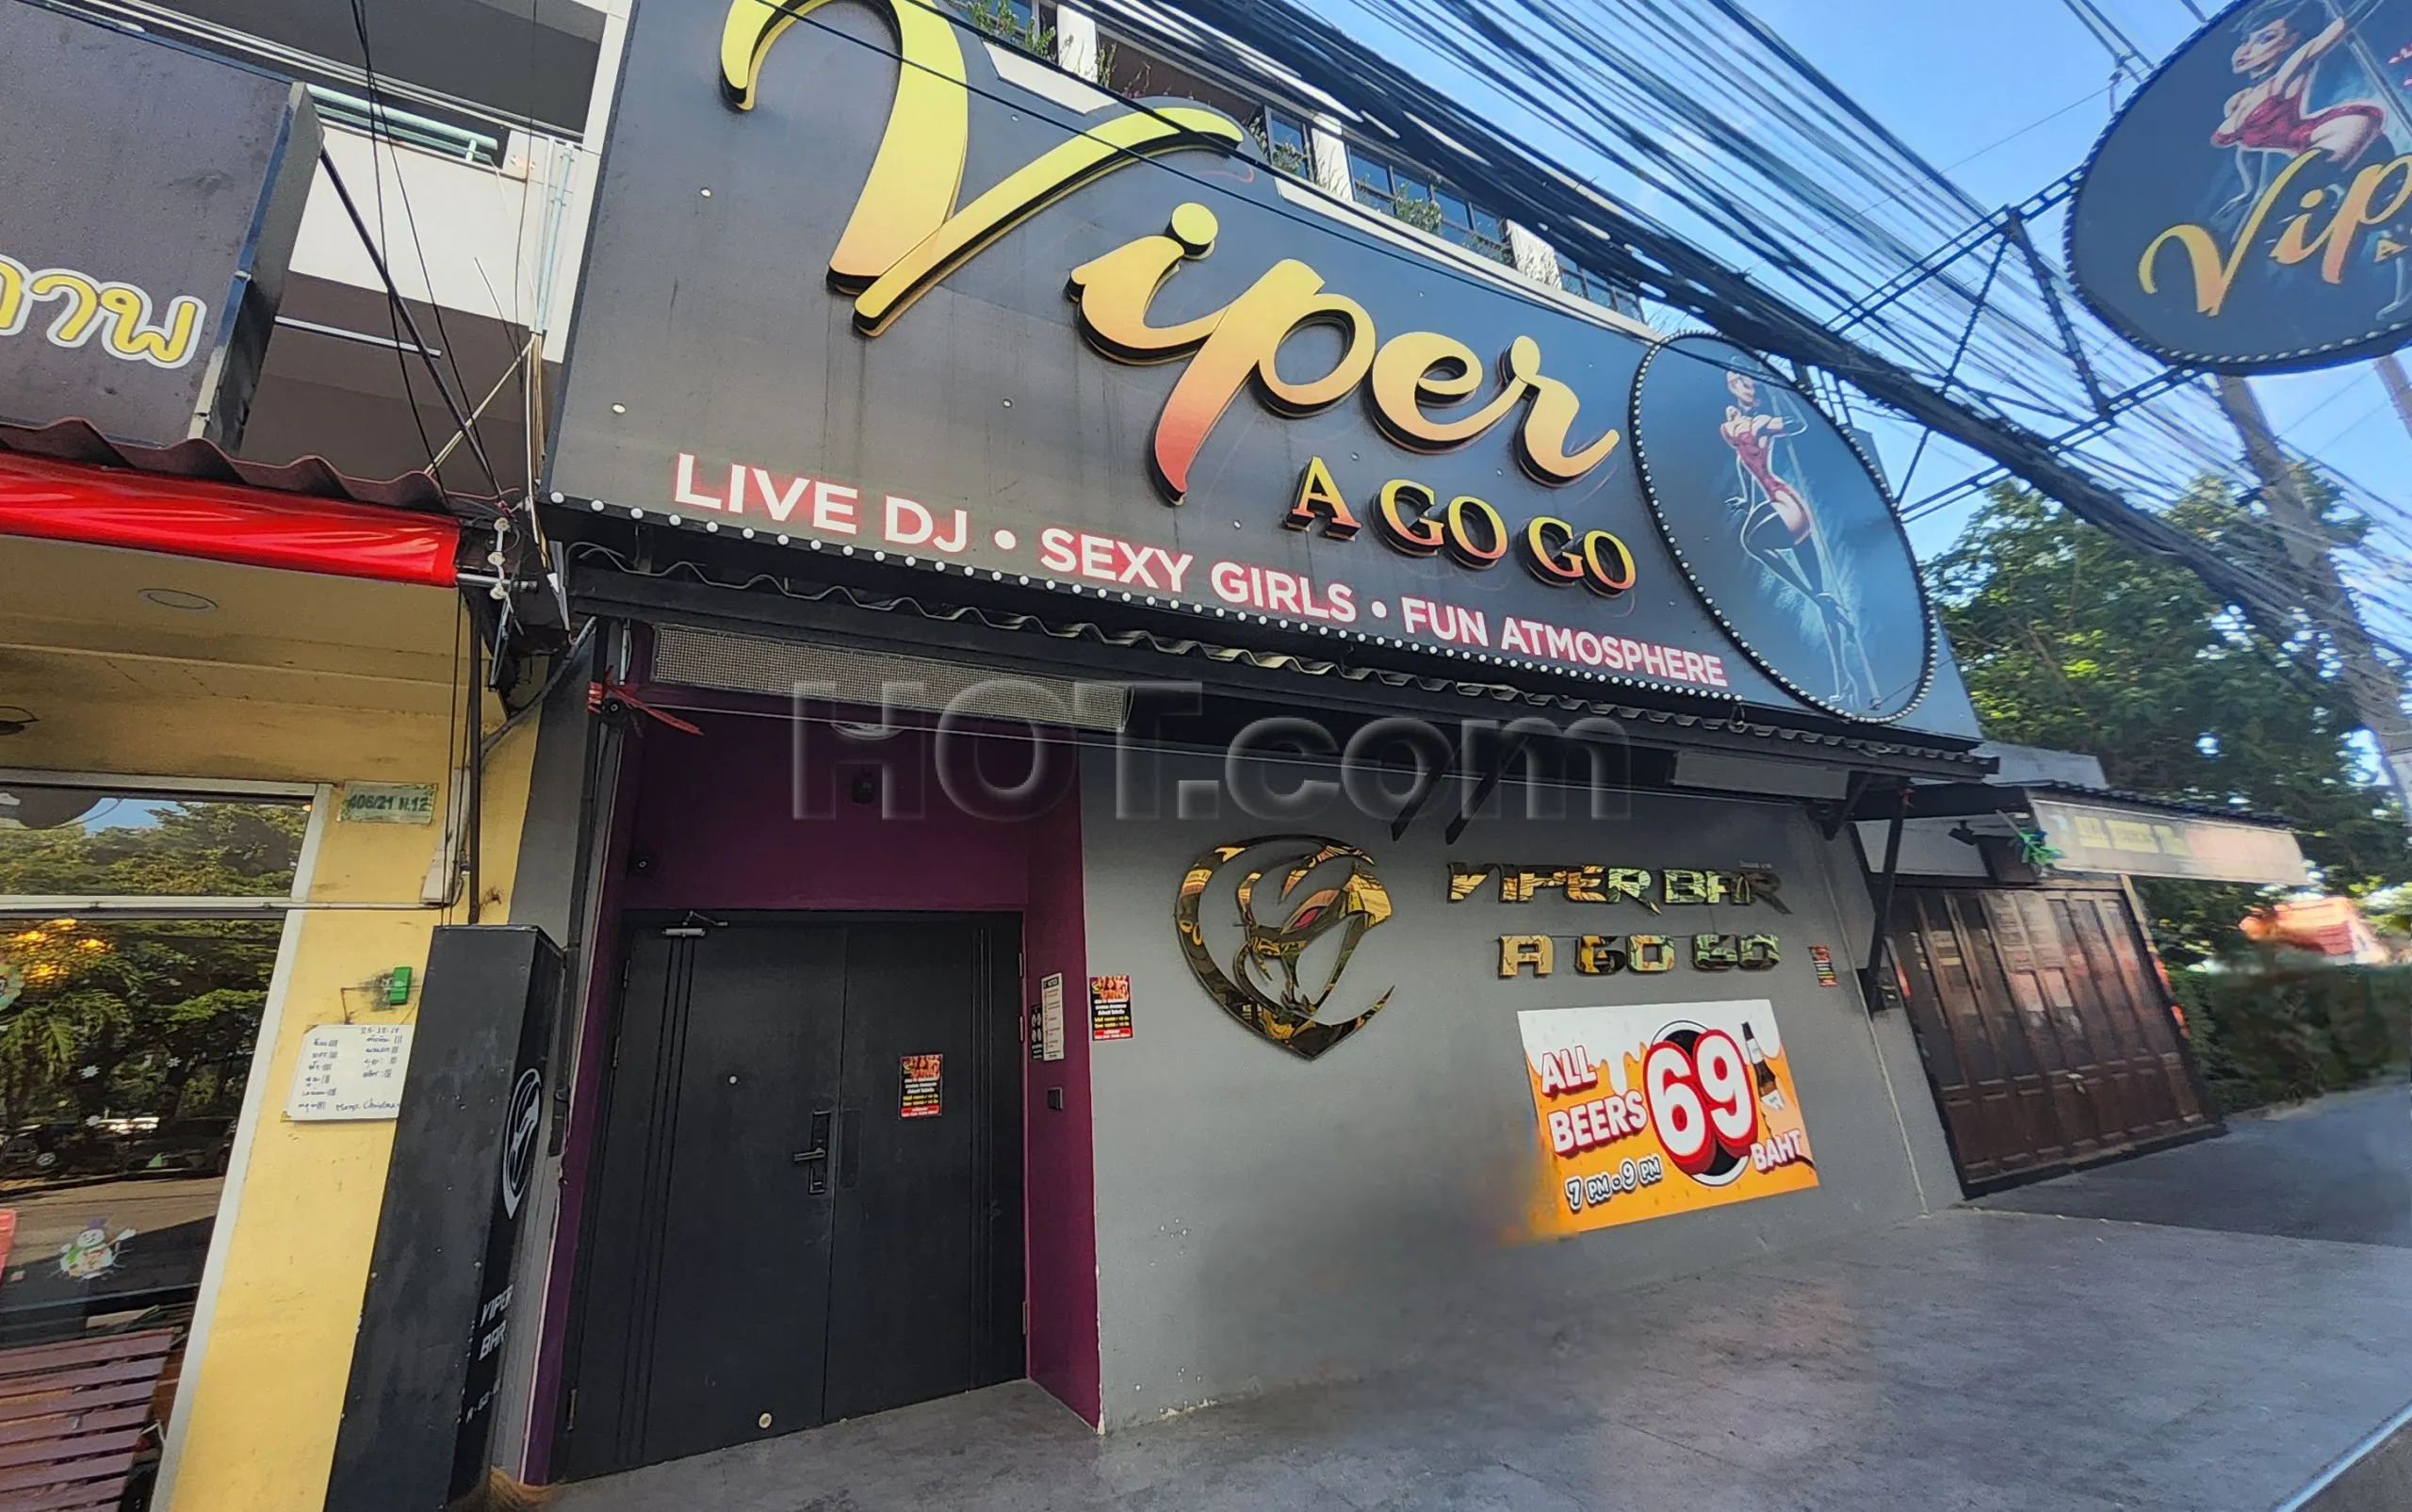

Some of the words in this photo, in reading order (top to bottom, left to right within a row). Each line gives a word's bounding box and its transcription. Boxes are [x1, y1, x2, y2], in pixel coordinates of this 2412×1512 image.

[721, 0, 1621, 507] Viper
[1286, 455, 1361, 542] A
[1371, 477, 1508, 568] GO
[1519, 514, 1638, 597] GO
[674, 452, 858, 534] LIVE
[884, 495, 968, 553] DJ
[1040, 528, 1194, 593] SEXY
[1211, 561, 1357, 623] GIRLS
[1401, 596, 1489, 647] FUN
[1500, 617, 1728, 688] ATMOSPHERE
[1447, 864, 1663, 916] VIPER
[1662, 868, 1792, 915] BAR
[1497, 934, 1554, 978] A
[1573, 934, 1675, 974] GO
[1692, 933, 1783, 972] GO
[1540, 1044, 1599, 1097] ALL
[1547, 1089, 1649, 1156] BEERS
[1643, 1029, 1759, 1174] 69
[1750, 1129, 1803, 1173] BAHT
[1565, 1176, 1584, 1211] 7
[1585, 1171, 1612, 1204] PM
[1620, 1157, 1638, 1191] 9
[1638, 1153, 1663, 1184] PM
[478, 1320, 507, 1361] BAR
